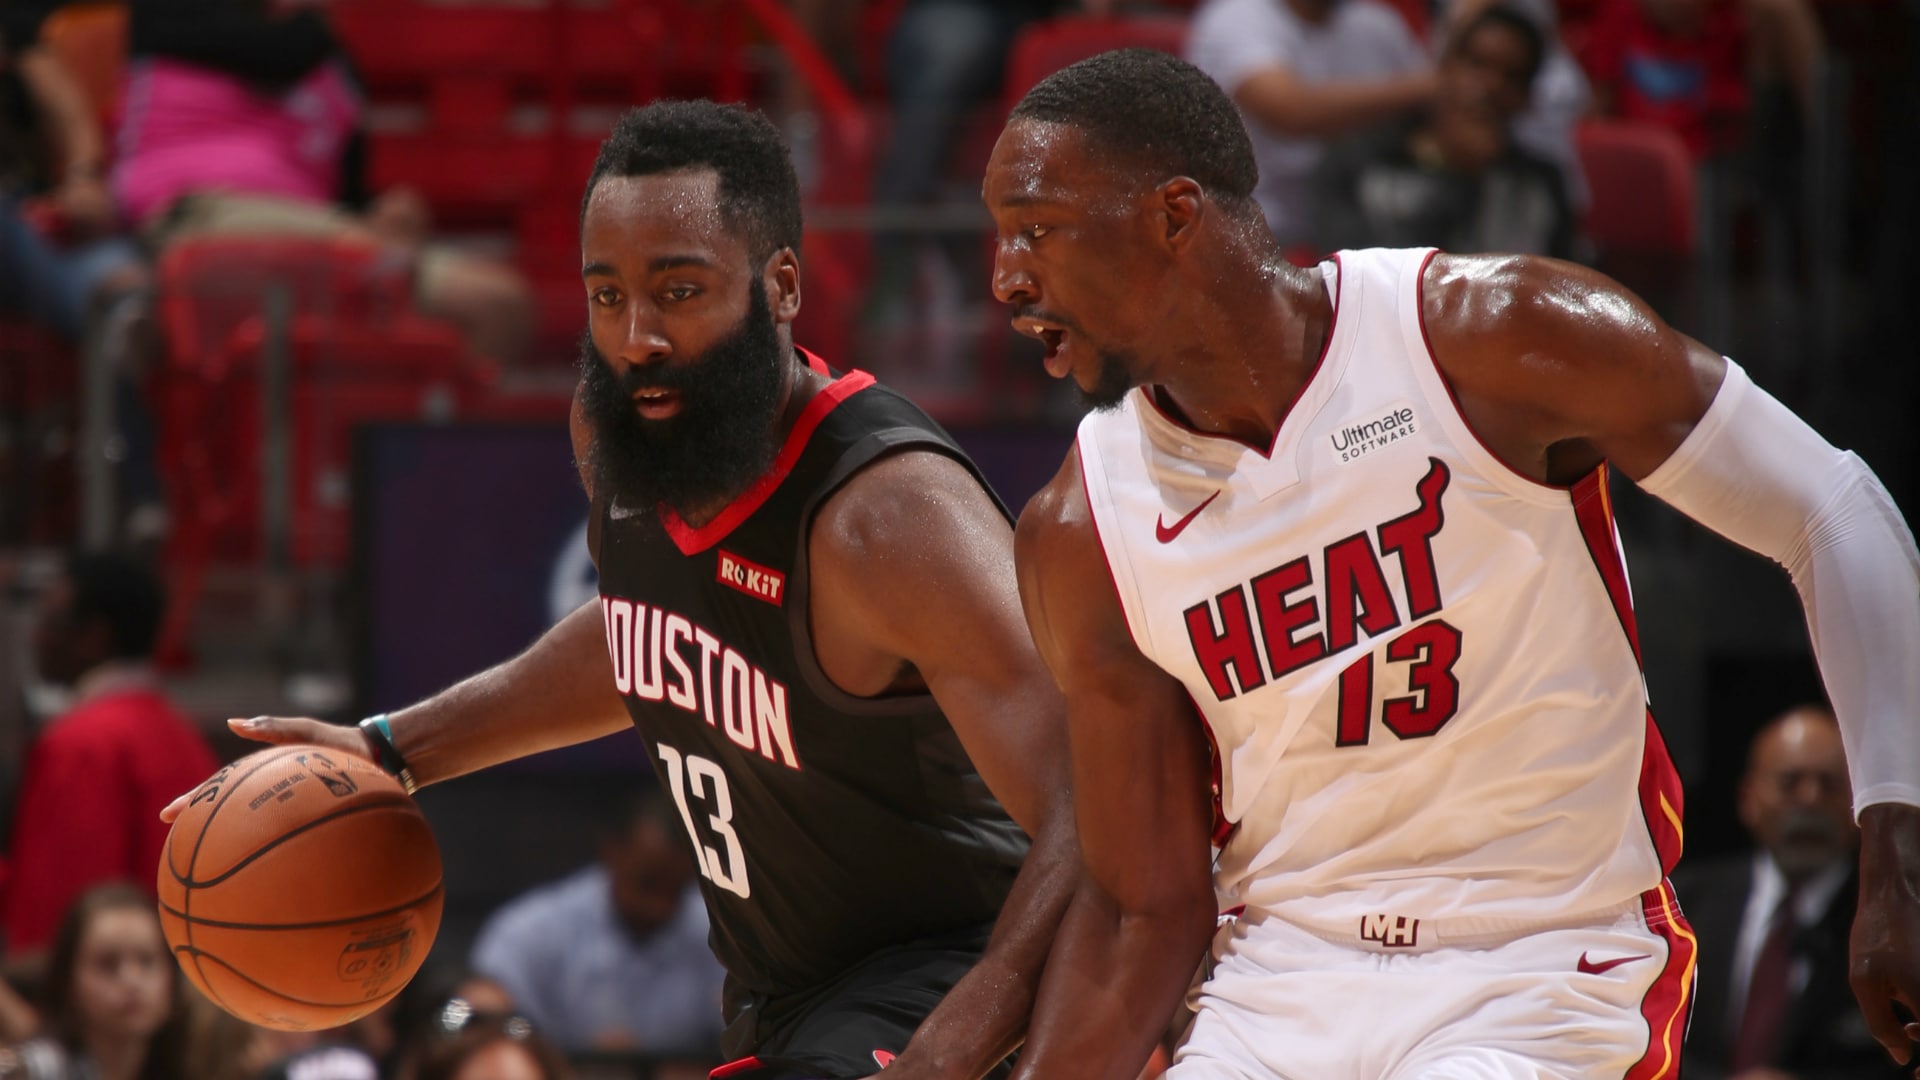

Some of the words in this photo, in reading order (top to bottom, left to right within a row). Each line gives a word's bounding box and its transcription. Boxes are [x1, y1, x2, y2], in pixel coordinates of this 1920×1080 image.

[1331, 408, 1413, 451] Ultimate
[1342, 424, 1415, 462] SOFTWARE
[1183, 456, 1451, 702] HEAT
[601, 596, 800, 771] OUSTON
[1335, 618, 1462, 747] 13
[657, 742, 750, 899] 13
